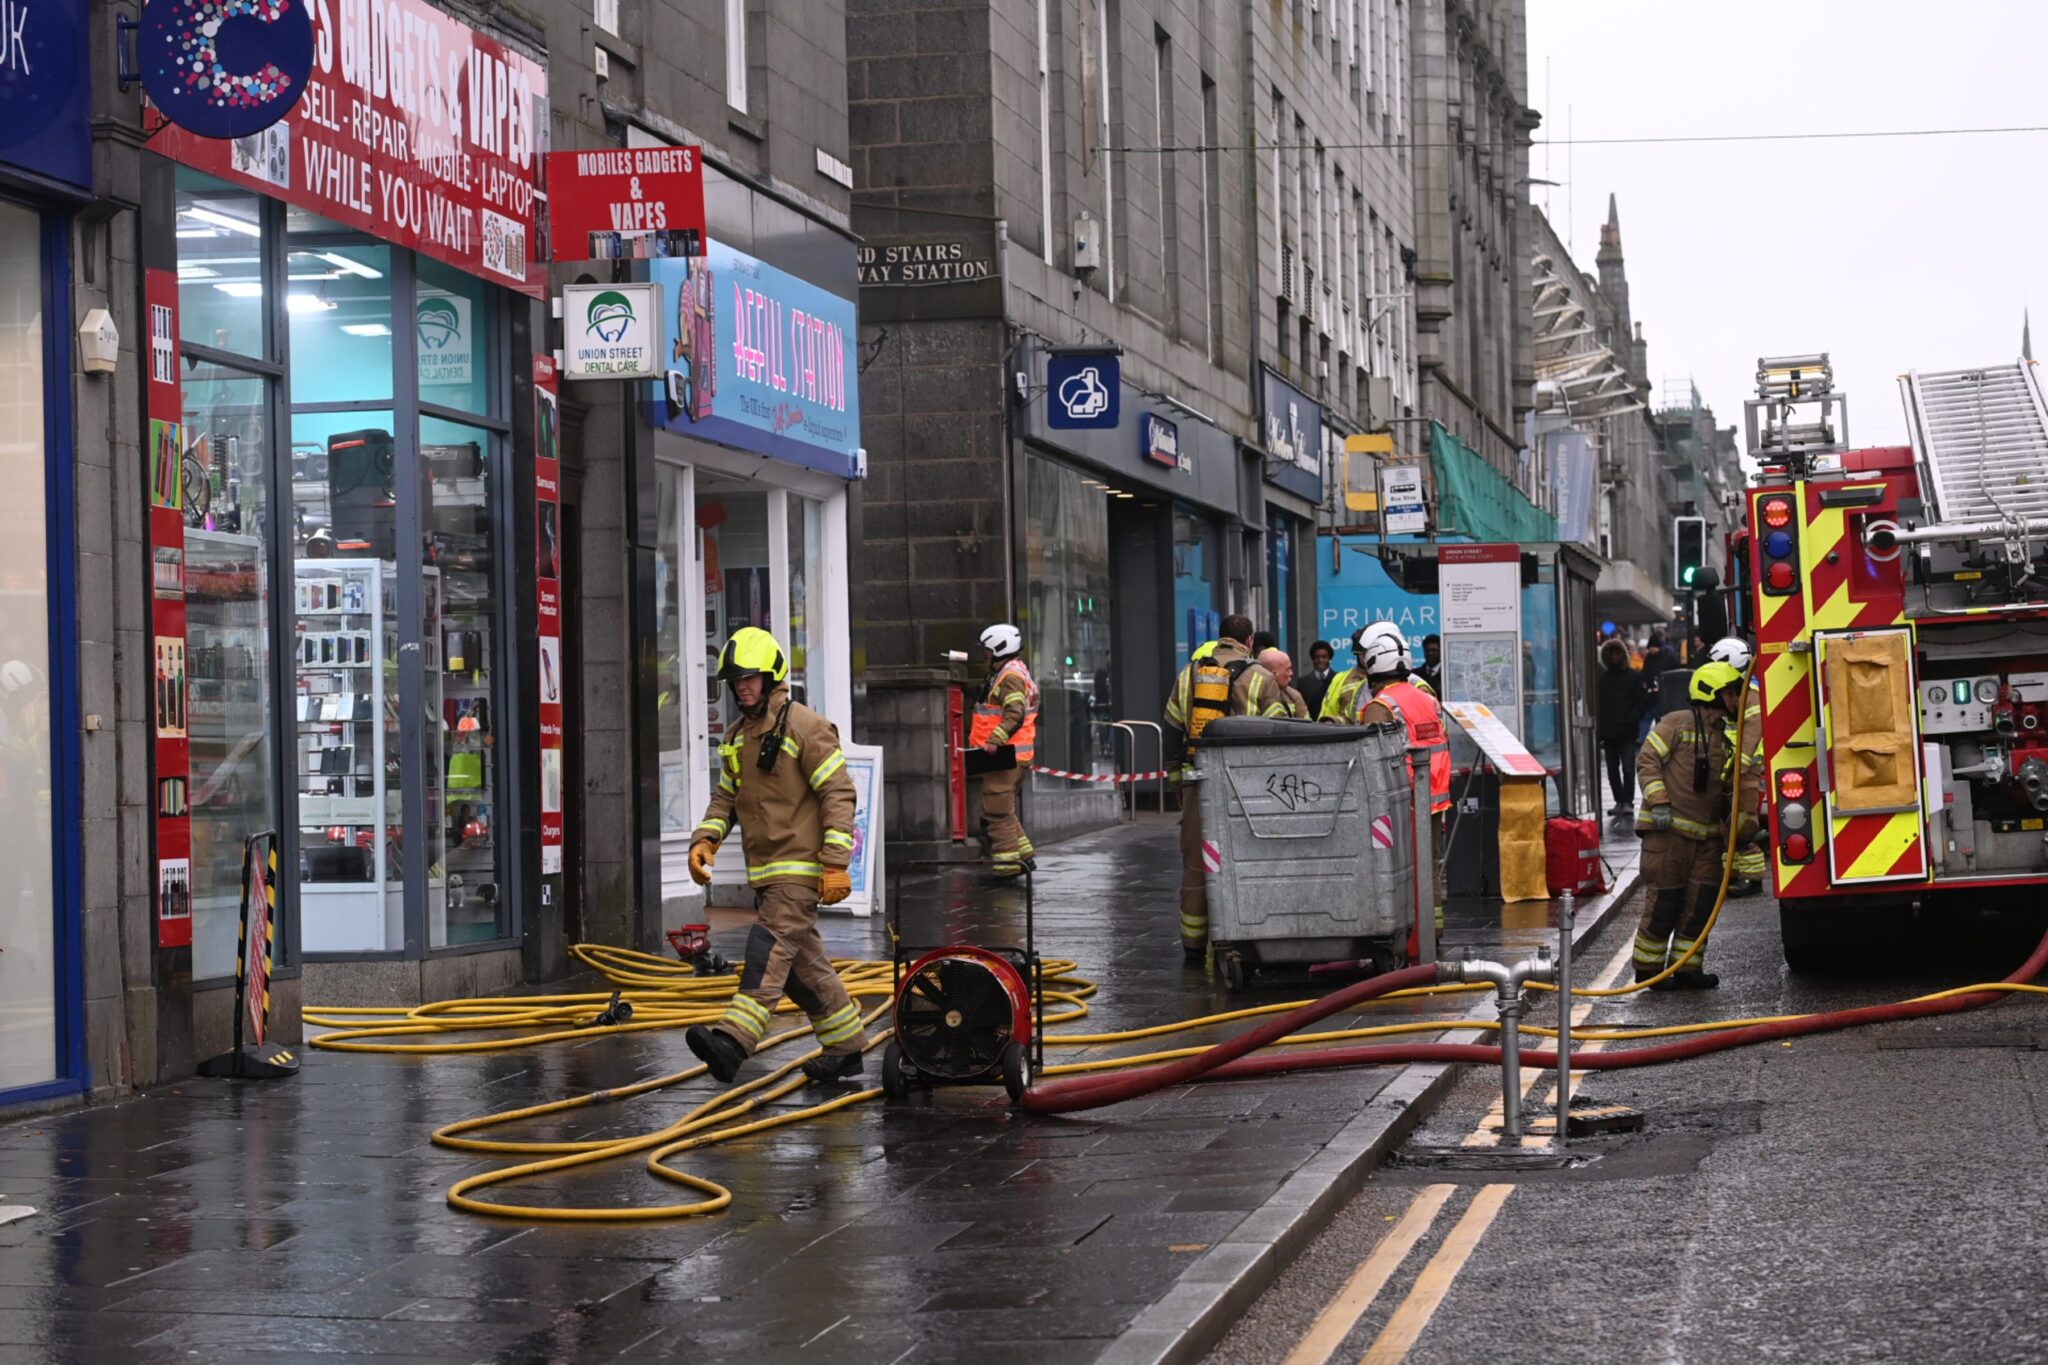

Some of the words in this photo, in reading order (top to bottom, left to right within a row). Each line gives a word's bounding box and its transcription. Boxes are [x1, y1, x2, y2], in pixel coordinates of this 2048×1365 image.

[340, 0, 441, 127] GADGETS
[449, 50, 463, 139] &
[467, 45, 533, 170] VAPES
[301, 80, 340, 132] SELL
[353, 99, 408, 163] REPAIR
[419, 133, 472, 192] MOBILE
[482, 162, 533, 217] LAPTOP
[577, 152, 633, 176] MOBILES
[635, 150, 692, 174] GADGETS
[303, 137, 372, 215] WHILE
[378, 170, 422, 235] YOU
[426, 190, 473, 255] WAIT
[630, 176, 643, 200] &
[610, 201, 666, 230] VAPES
[886, 244, 962, 263] STAIRS
[902, 261, 988, 281] STATION
[578, 348, 607, 360] UNION
[609, 347, 643, 359] STREET
[790, 308, 844, 412] STATION
[585, 361, 616, 373] DENTAL
[617, 361, 639, 372] CARE
[1323, 606, 1435, 628] PRIMAR
